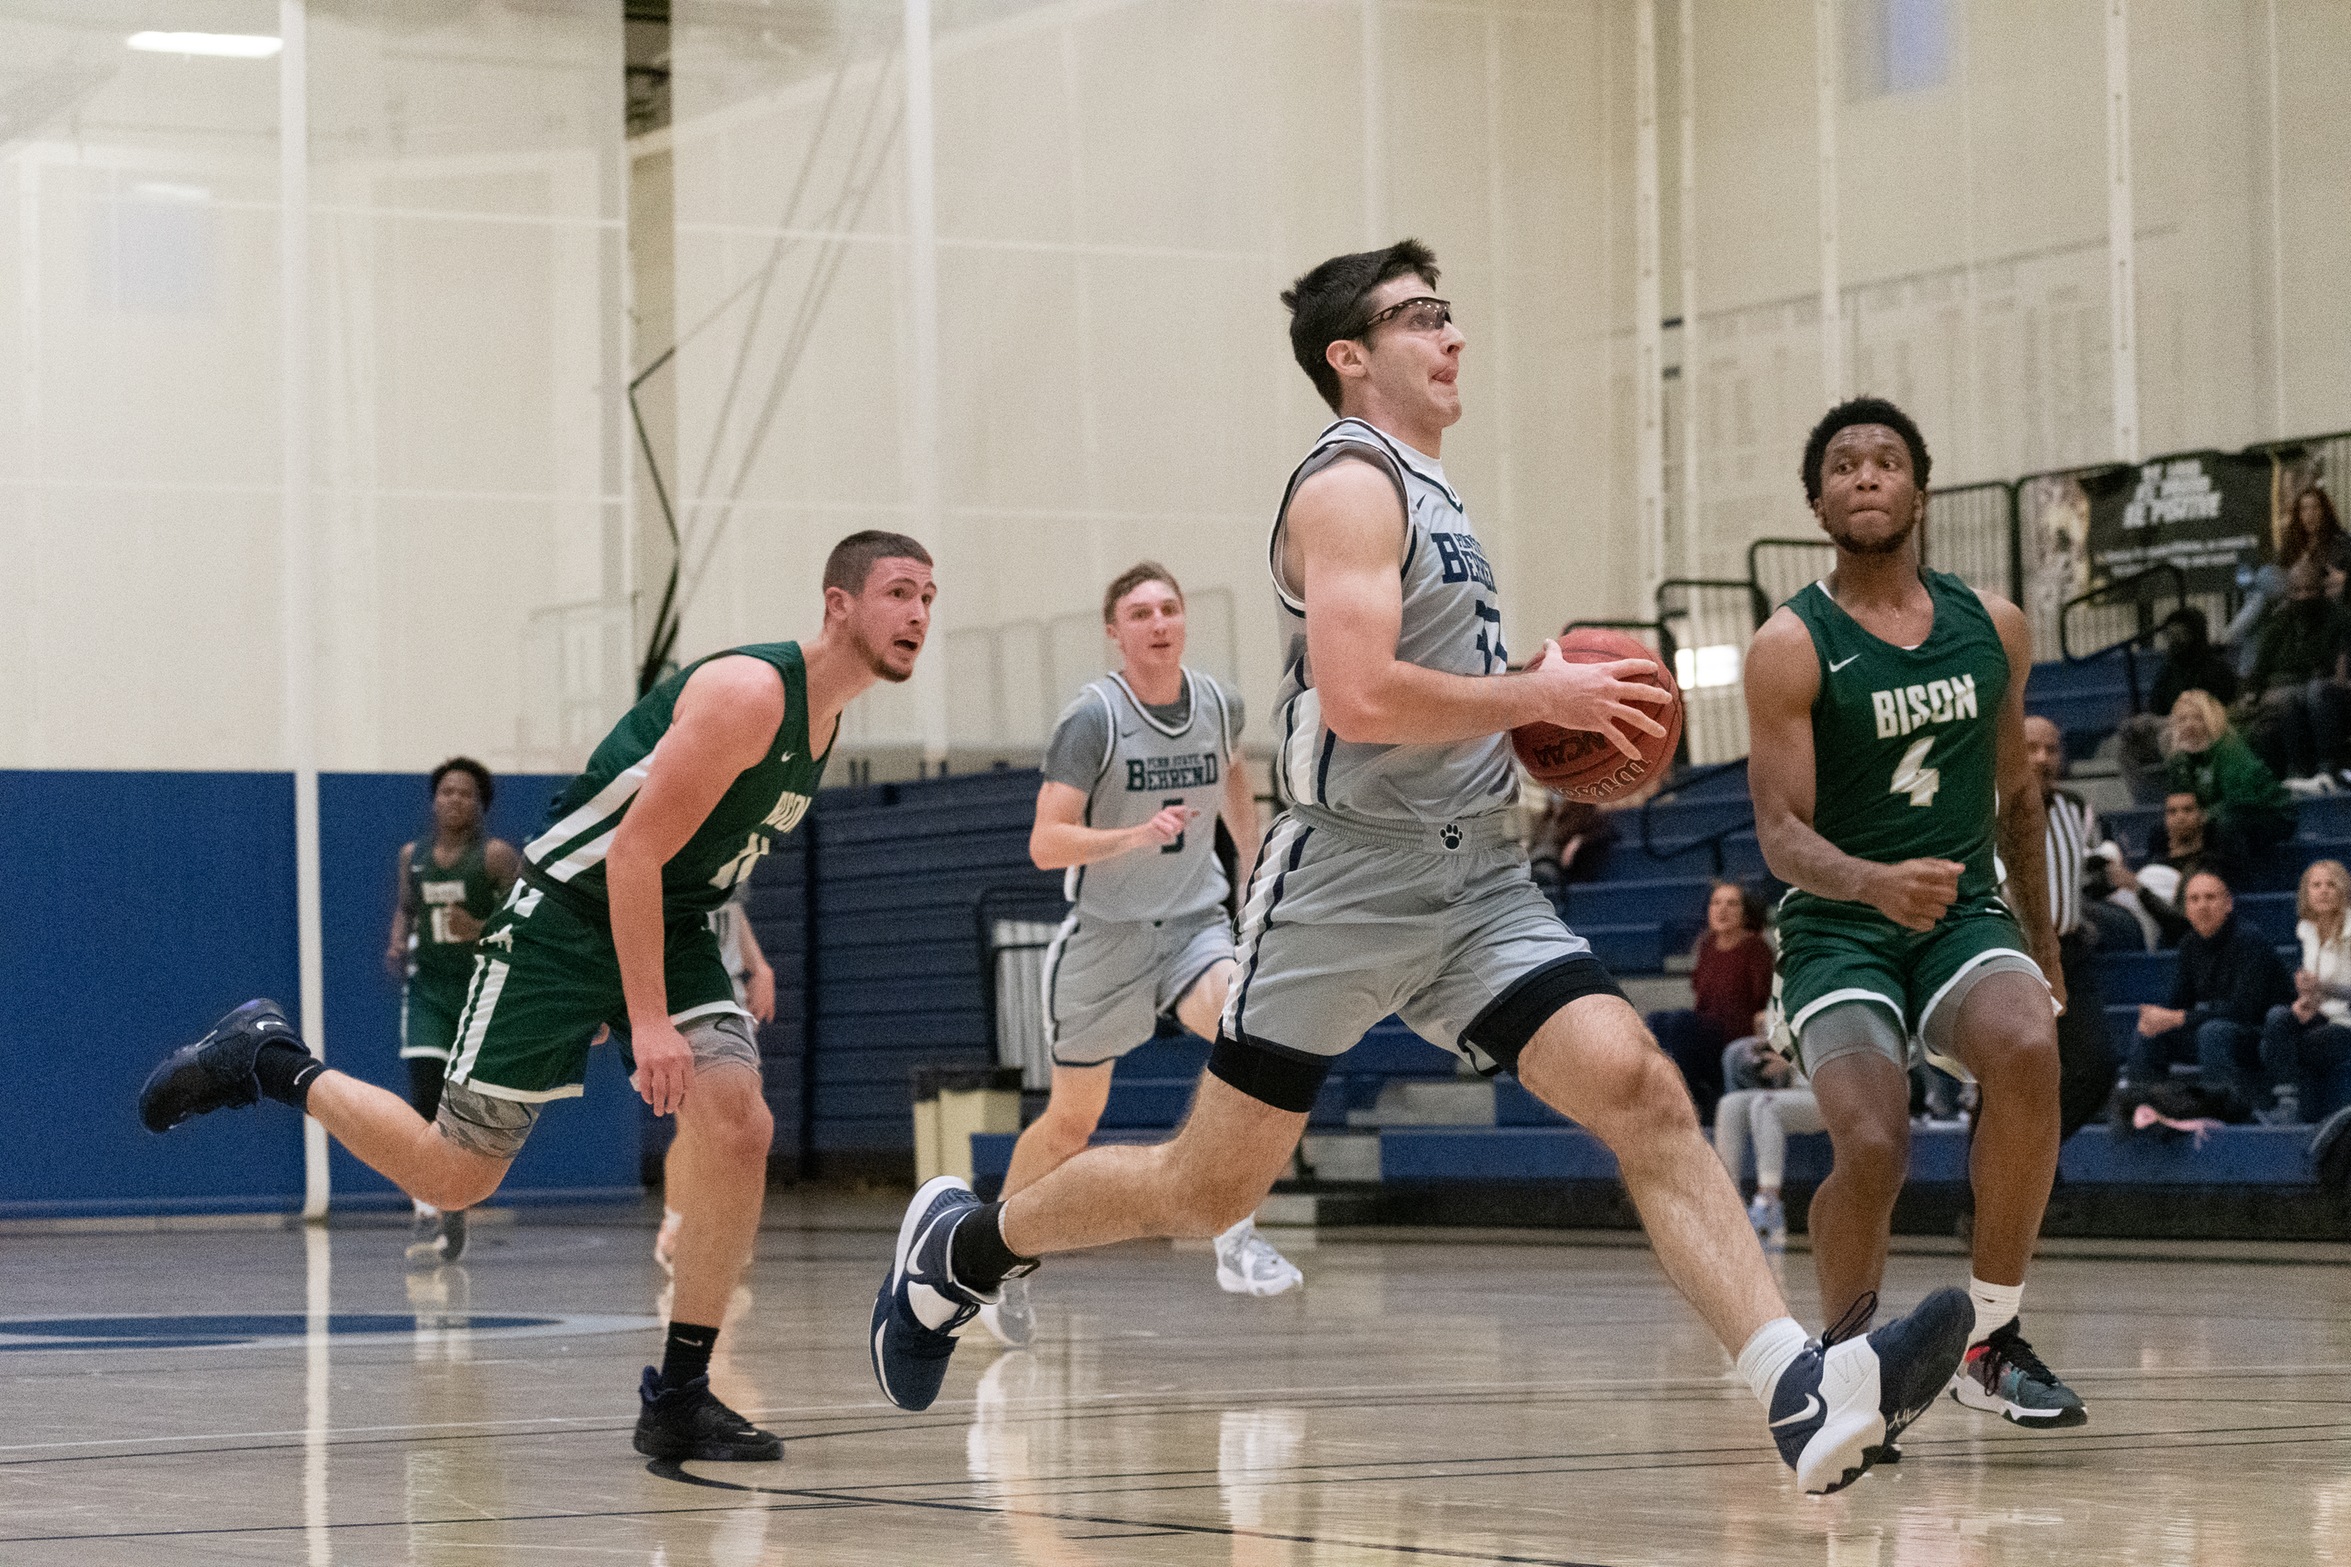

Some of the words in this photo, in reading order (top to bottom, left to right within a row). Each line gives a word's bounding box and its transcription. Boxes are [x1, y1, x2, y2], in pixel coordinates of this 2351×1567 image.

[1871, 673, 1978, 740] BISON
[1126, 752, 1218, 792] BEHREND
[1889, 735, 1941, 807] 4
